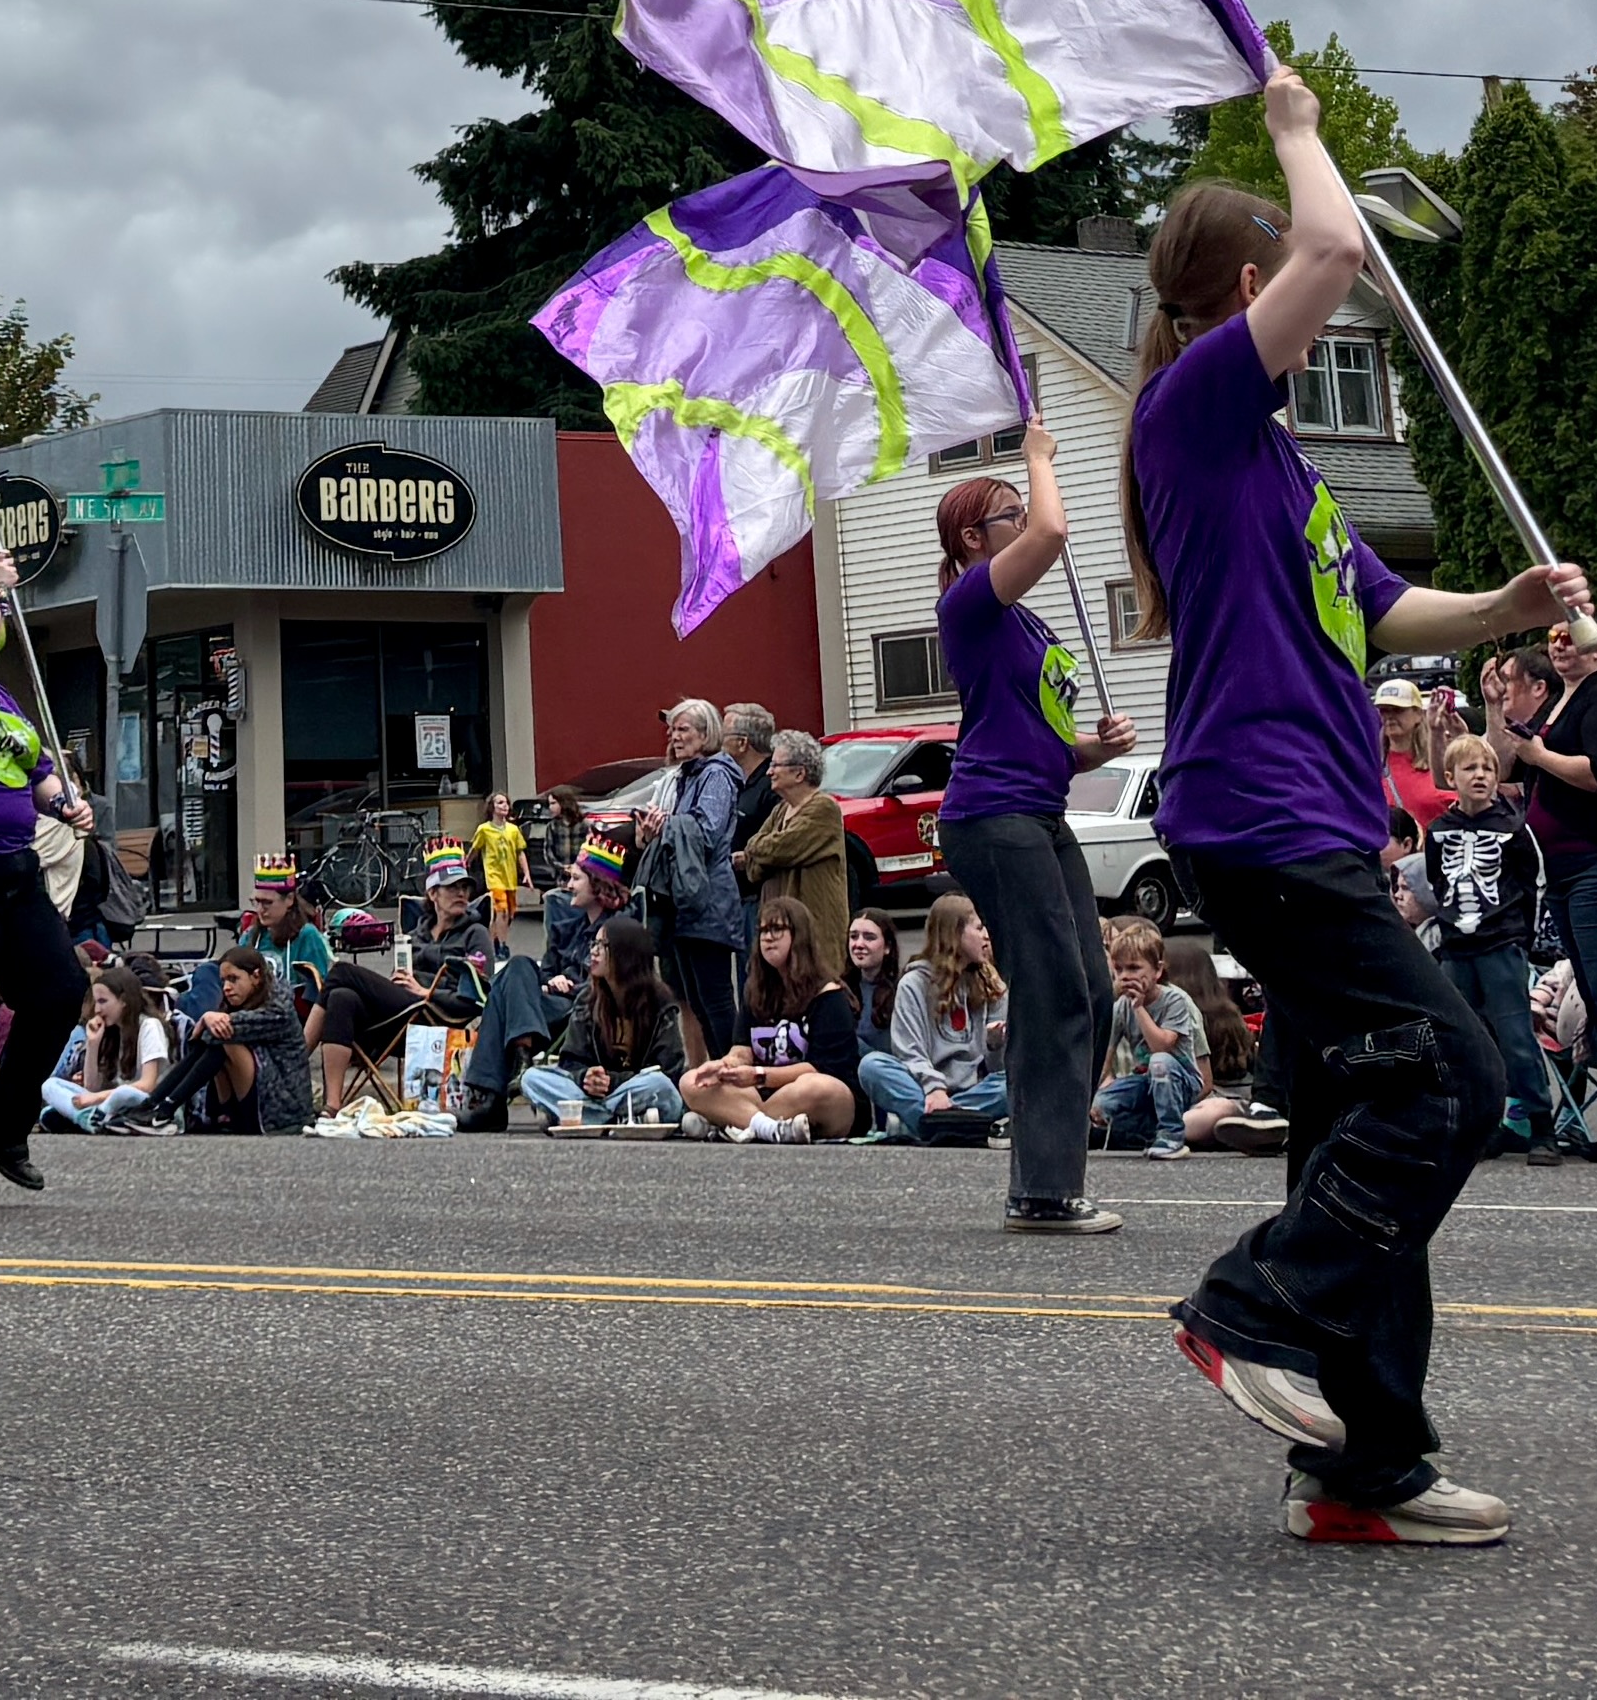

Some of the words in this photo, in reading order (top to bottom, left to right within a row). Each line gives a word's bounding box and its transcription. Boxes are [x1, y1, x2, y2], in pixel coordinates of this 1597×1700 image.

[345, 462, 370, 474] THE
[75, 499, 96, 519] NE
[423, 732, 446, 756] 25
